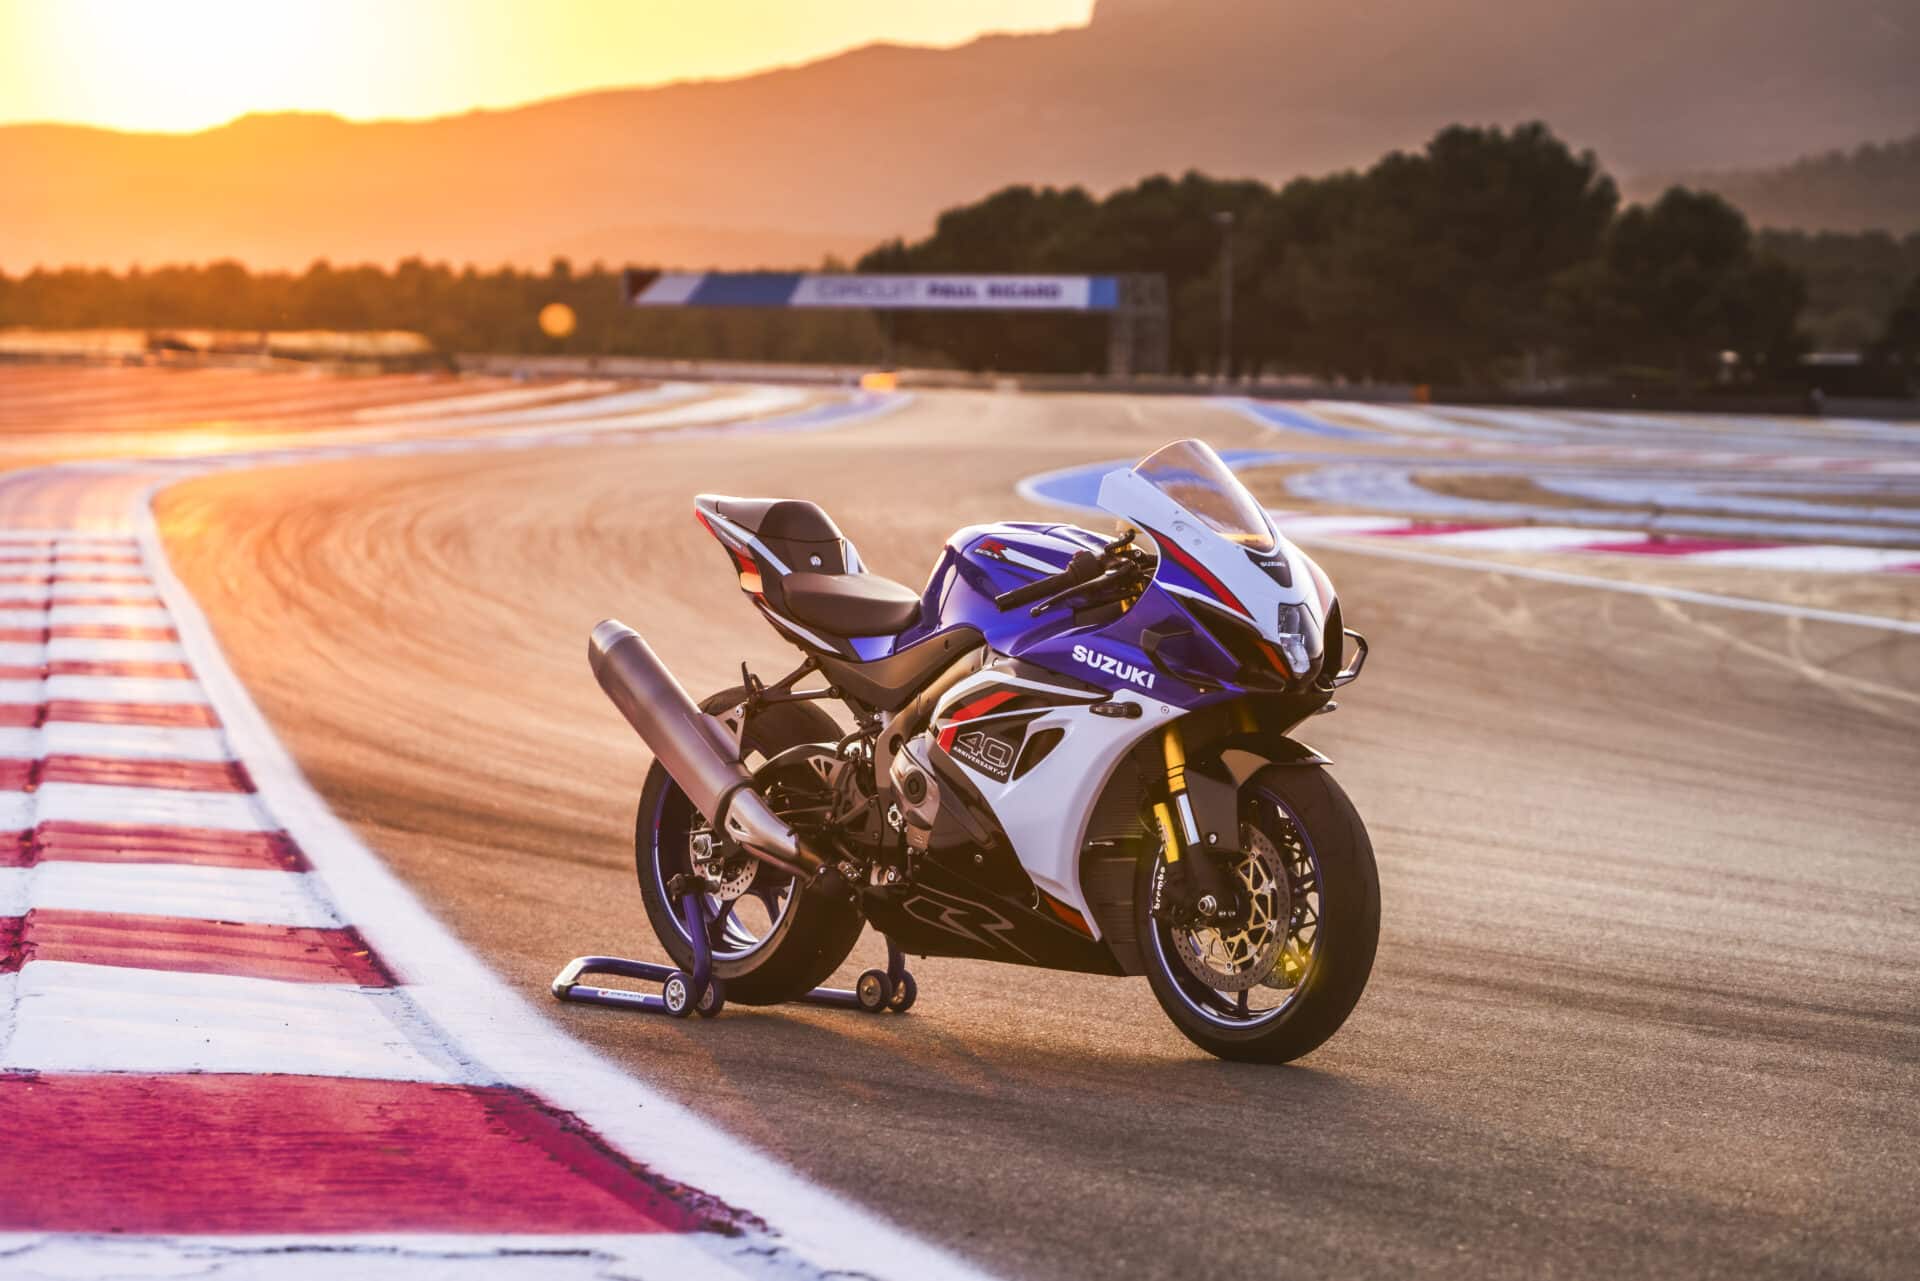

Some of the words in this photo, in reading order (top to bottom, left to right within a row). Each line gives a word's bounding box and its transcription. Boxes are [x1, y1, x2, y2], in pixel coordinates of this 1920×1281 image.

[926, 281, 976, 298] PAUL
[986, 281, 1061, 298] RICARD
[1072, 645, 1156, 689] SUZUKI
[952, 746, 999, 773] ANNIVERSARY
[957, 731, 1014, 769] 40
[1153, 866, 1166, 910] brembo
